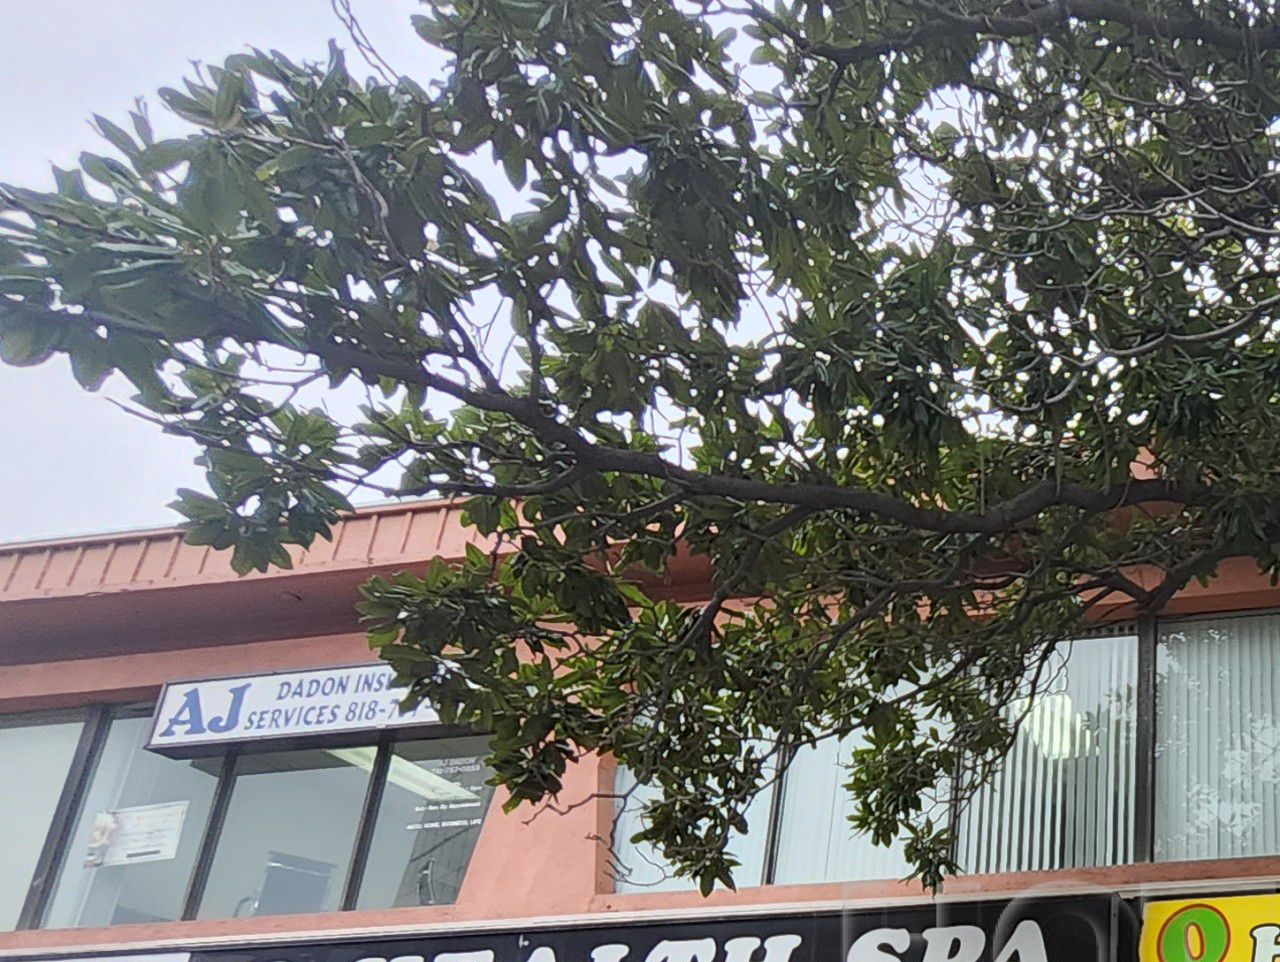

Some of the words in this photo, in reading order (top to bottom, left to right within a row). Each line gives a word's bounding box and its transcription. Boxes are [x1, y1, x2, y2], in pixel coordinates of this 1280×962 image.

[277, 674, 351, 701] DADON
[158, 683, 252, 738] AJ
[243, 704, 340, 731] SERVICES
